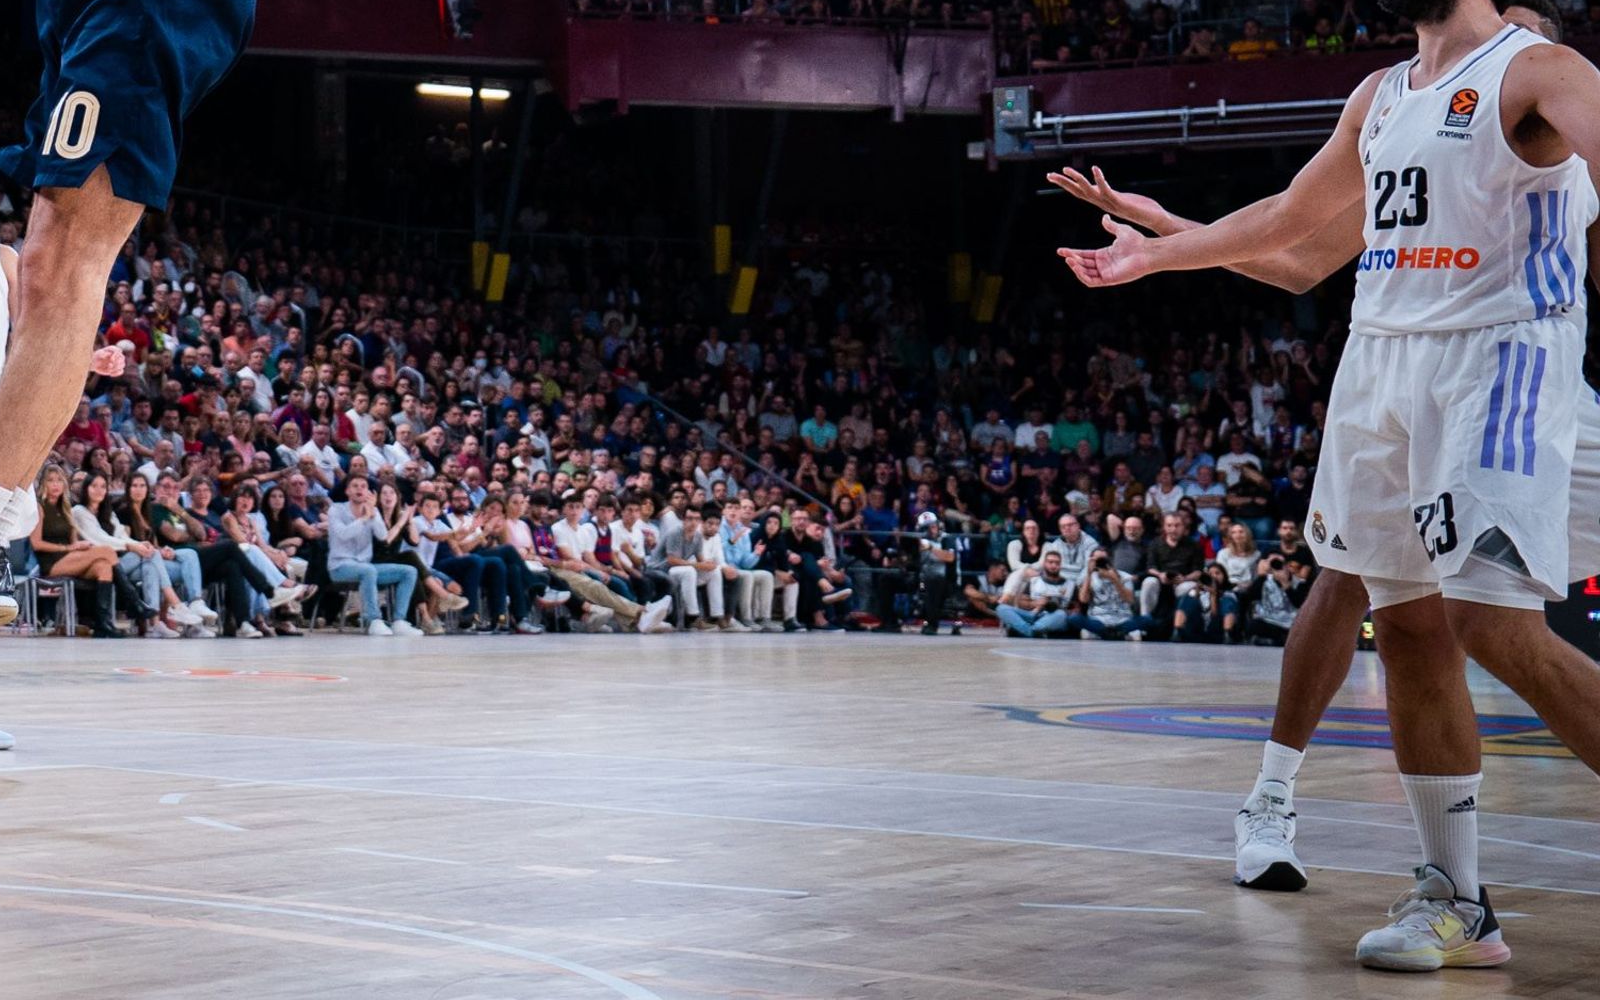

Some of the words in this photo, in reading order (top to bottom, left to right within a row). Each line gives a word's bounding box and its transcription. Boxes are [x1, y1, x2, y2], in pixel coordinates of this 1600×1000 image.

[42, 90, 100, 159] 10
[1437, 130, 1472, 140] oneteam
[1375, 166, 1428, 230] 23
[1414, 492, 1458, 562] 23
